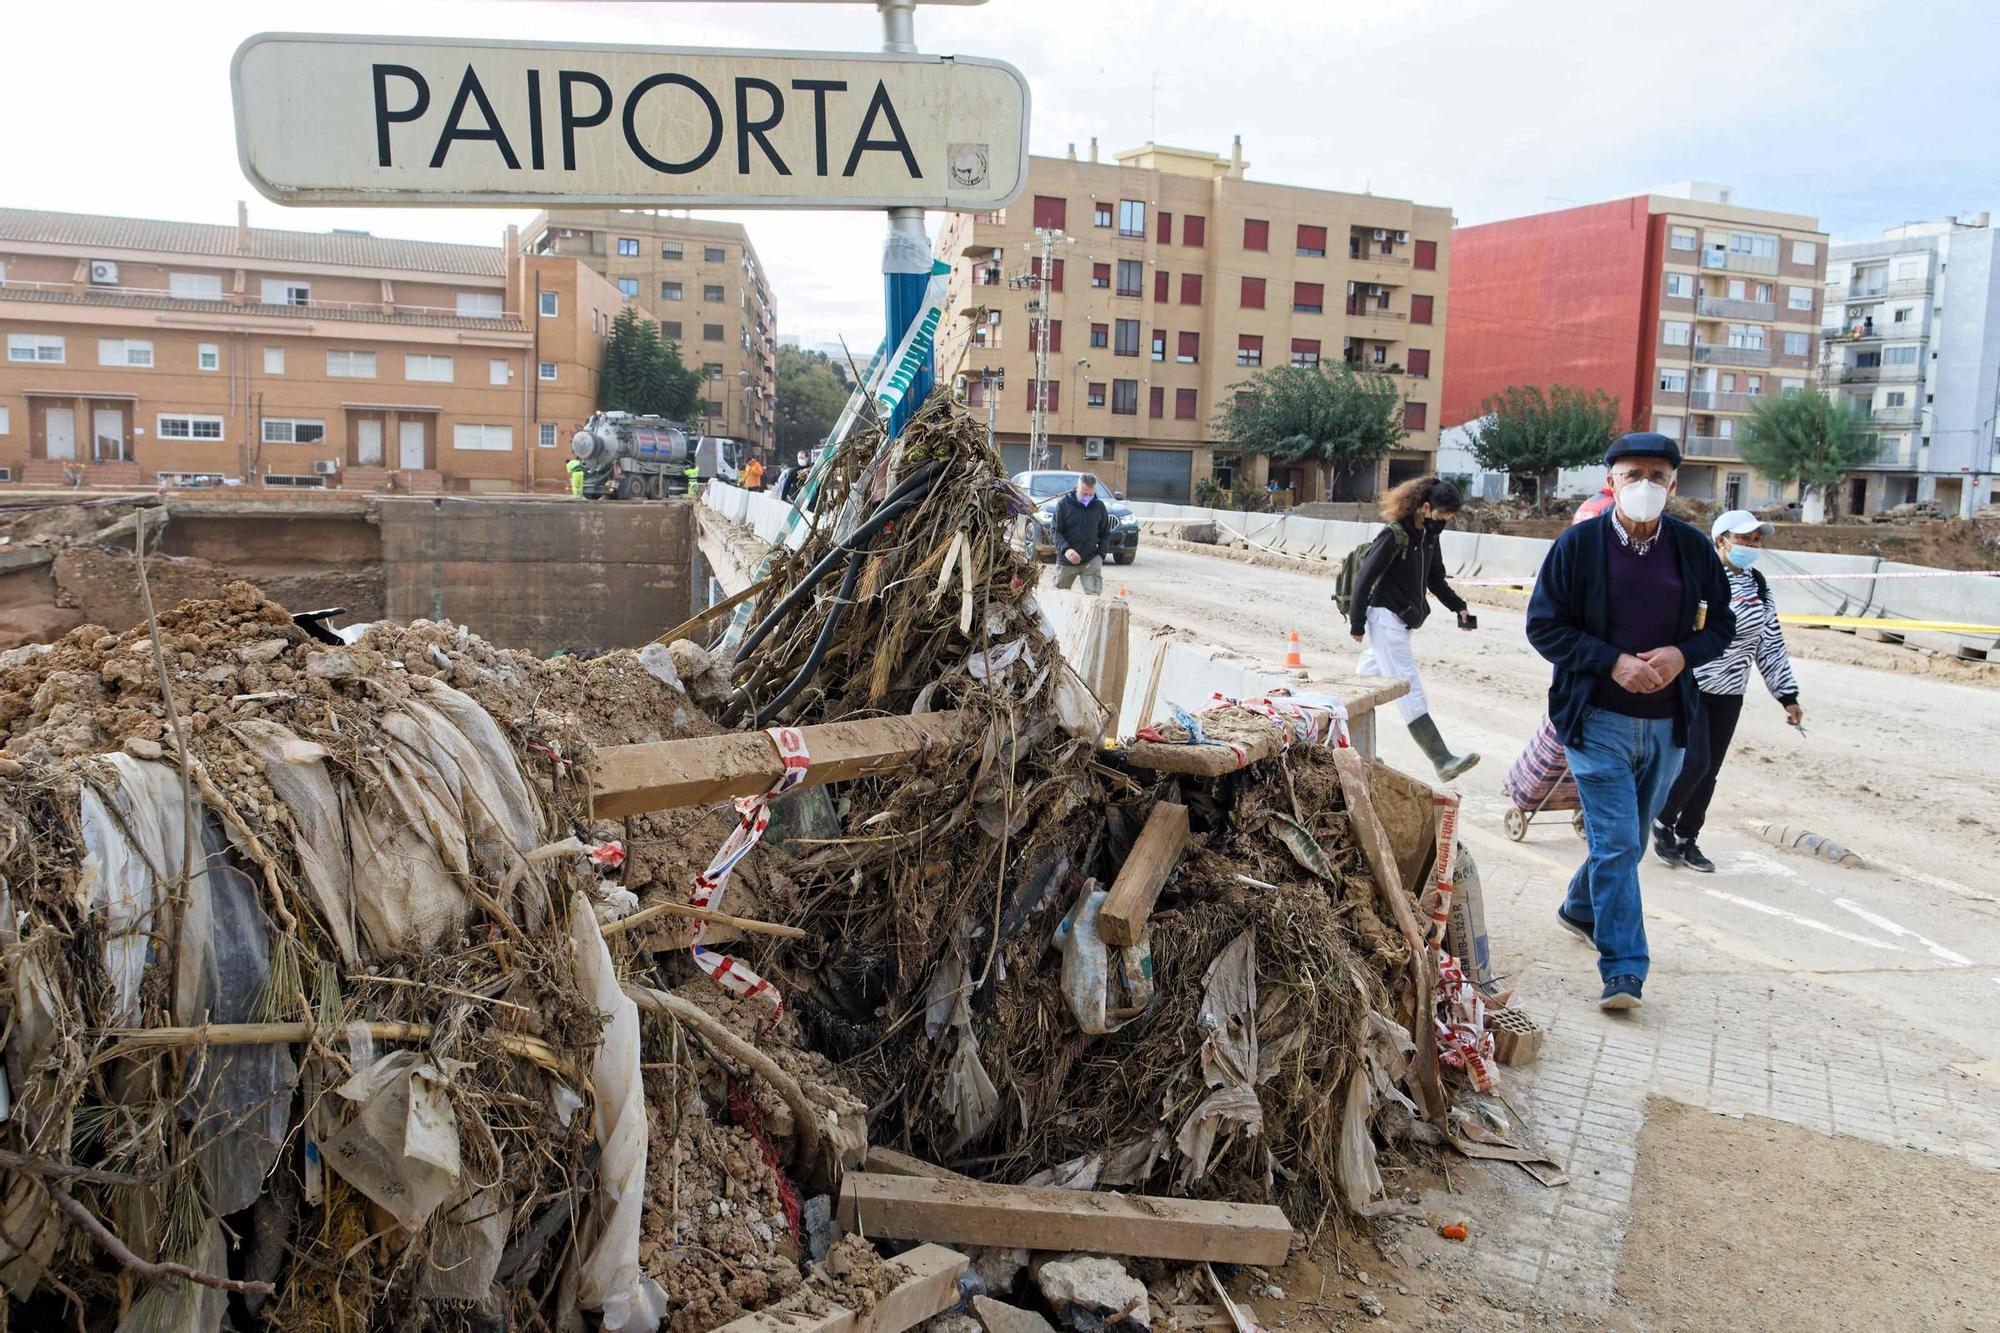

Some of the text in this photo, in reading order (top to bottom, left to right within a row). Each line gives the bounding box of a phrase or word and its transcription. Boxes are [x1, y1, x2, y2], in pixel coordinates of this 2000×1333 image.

[372, 62, 923, 178] PAIPORTA
[887, 306, 942, 394] GUARDIA
[1441, 808, 1456, 839] FORAL
[1453, 903, 1462, 912] R
[1454, 914, 1465, 931] 32,5
